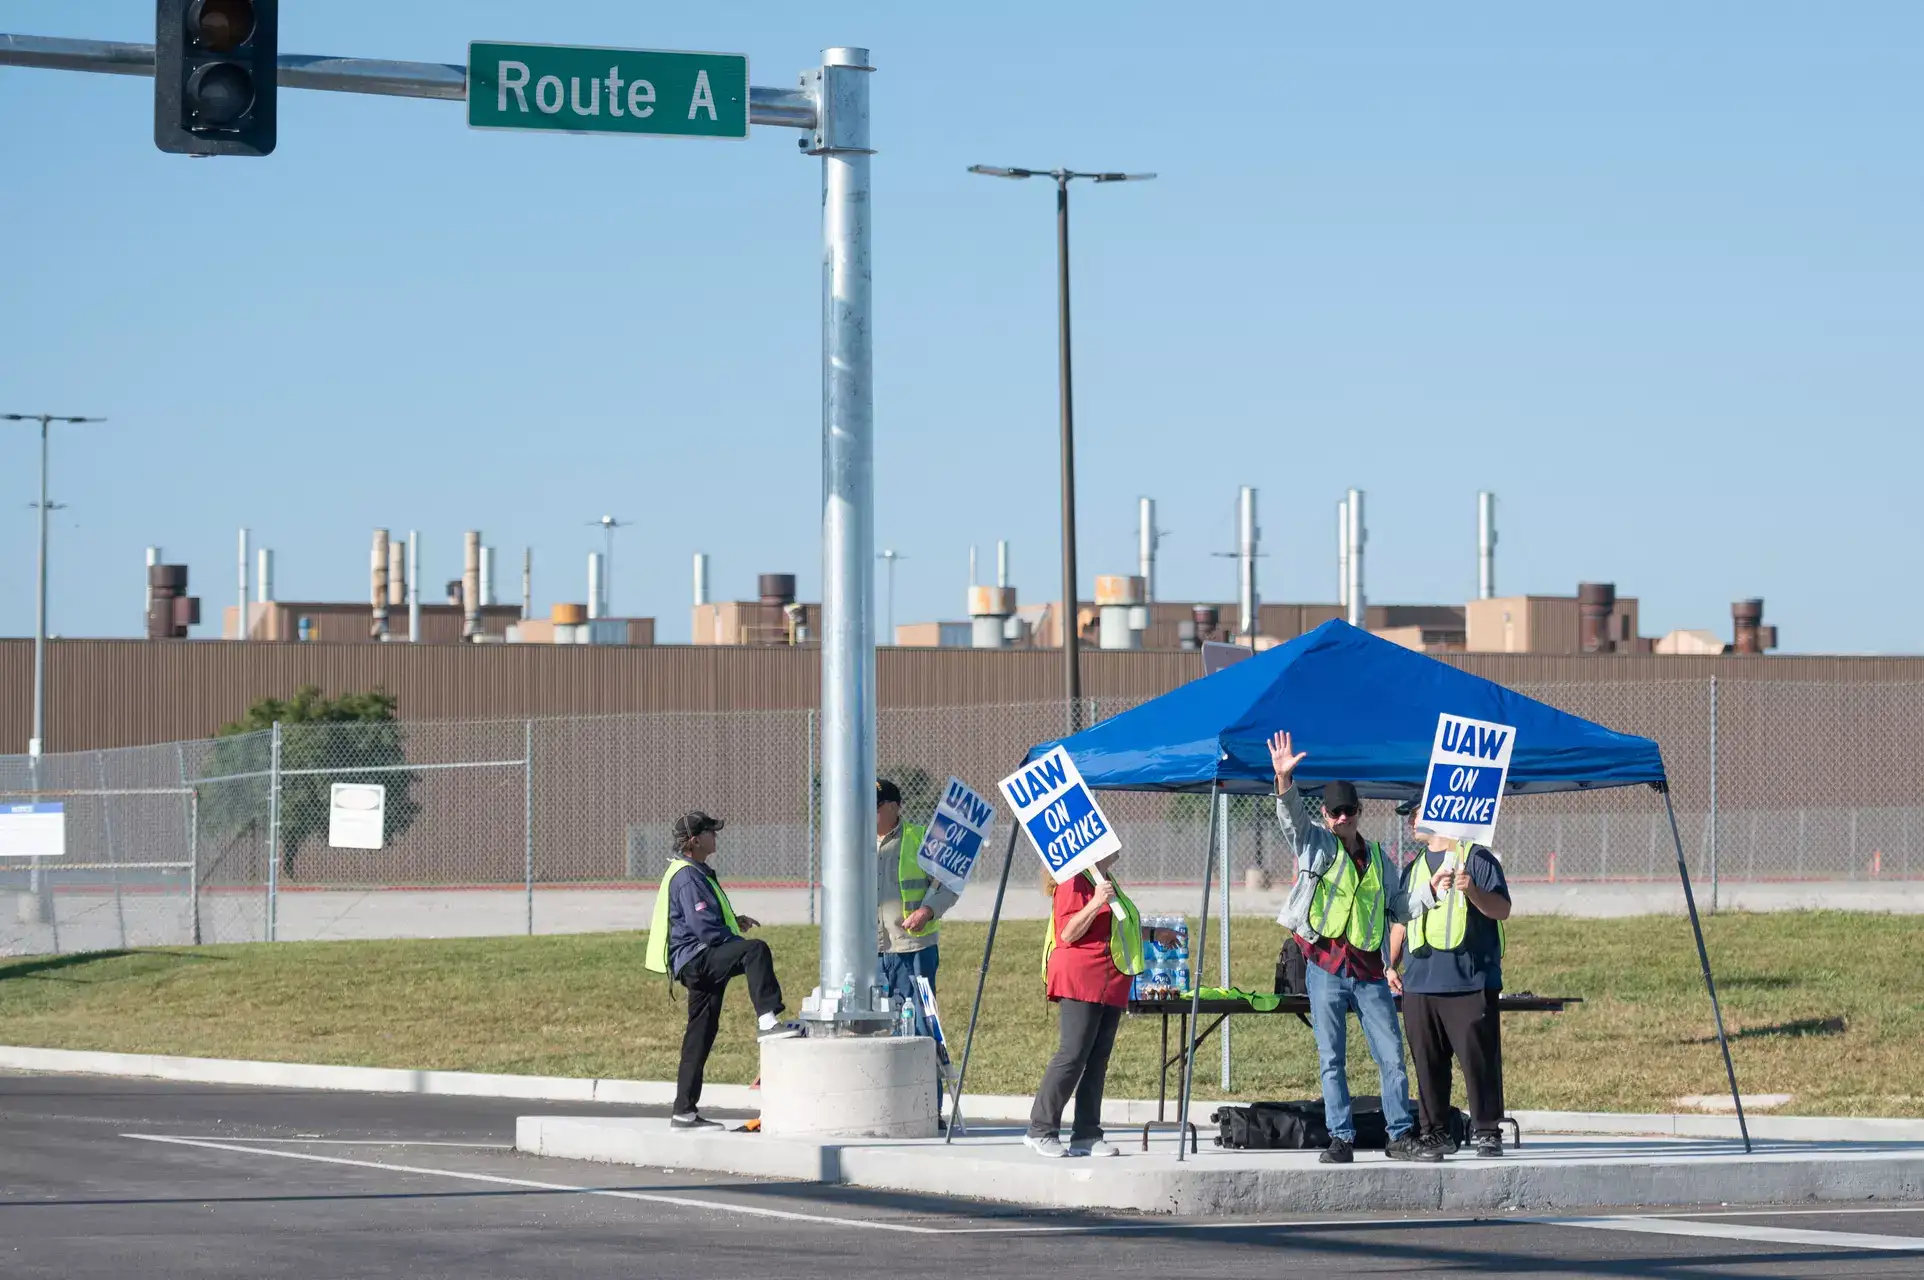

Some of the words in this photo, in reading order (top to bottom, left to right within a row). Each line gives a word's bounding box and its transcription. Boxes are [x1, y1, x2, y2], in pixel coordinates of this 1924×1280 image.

[497, 60, 656, 118] Route
[687, 69, 718, 121] A
[1441, 720, 1508, 761] UAW
[1006, 754, 1067, 809] UAW
[1449, 767, 1479, 793] ON
[946, 781, 992, 828] UAW
[1044, 798, 1071, 833] ON
[1427, 794, 1495, 822] STRIKE
[944, 822, 968, 846] ON
[1047, 809, 1102, 866] STRIKE
[924, 839, 972, 875] STRIKE
